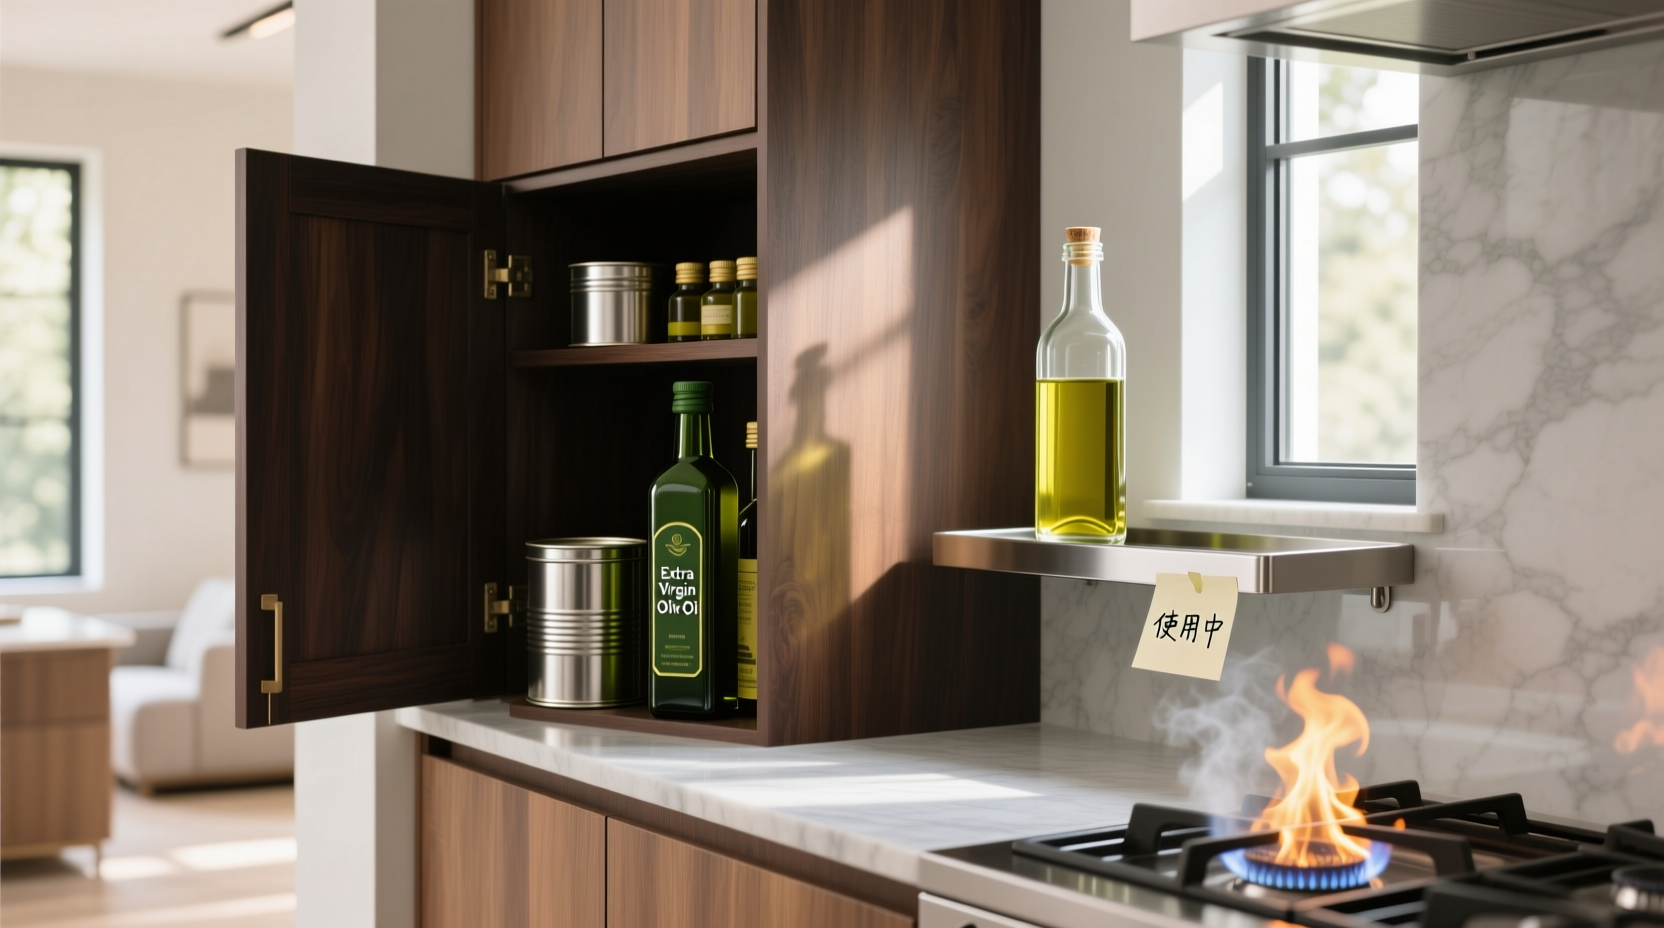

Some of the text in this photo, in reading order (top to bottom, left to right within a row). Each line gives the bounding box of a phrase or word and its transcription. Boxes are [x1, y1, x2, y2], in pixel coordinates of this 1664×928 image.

[661, 566, 694, 580] Extra
[658, 582, 696, 600] Virgin
[1153, 609, 1224, 649] 使用中
